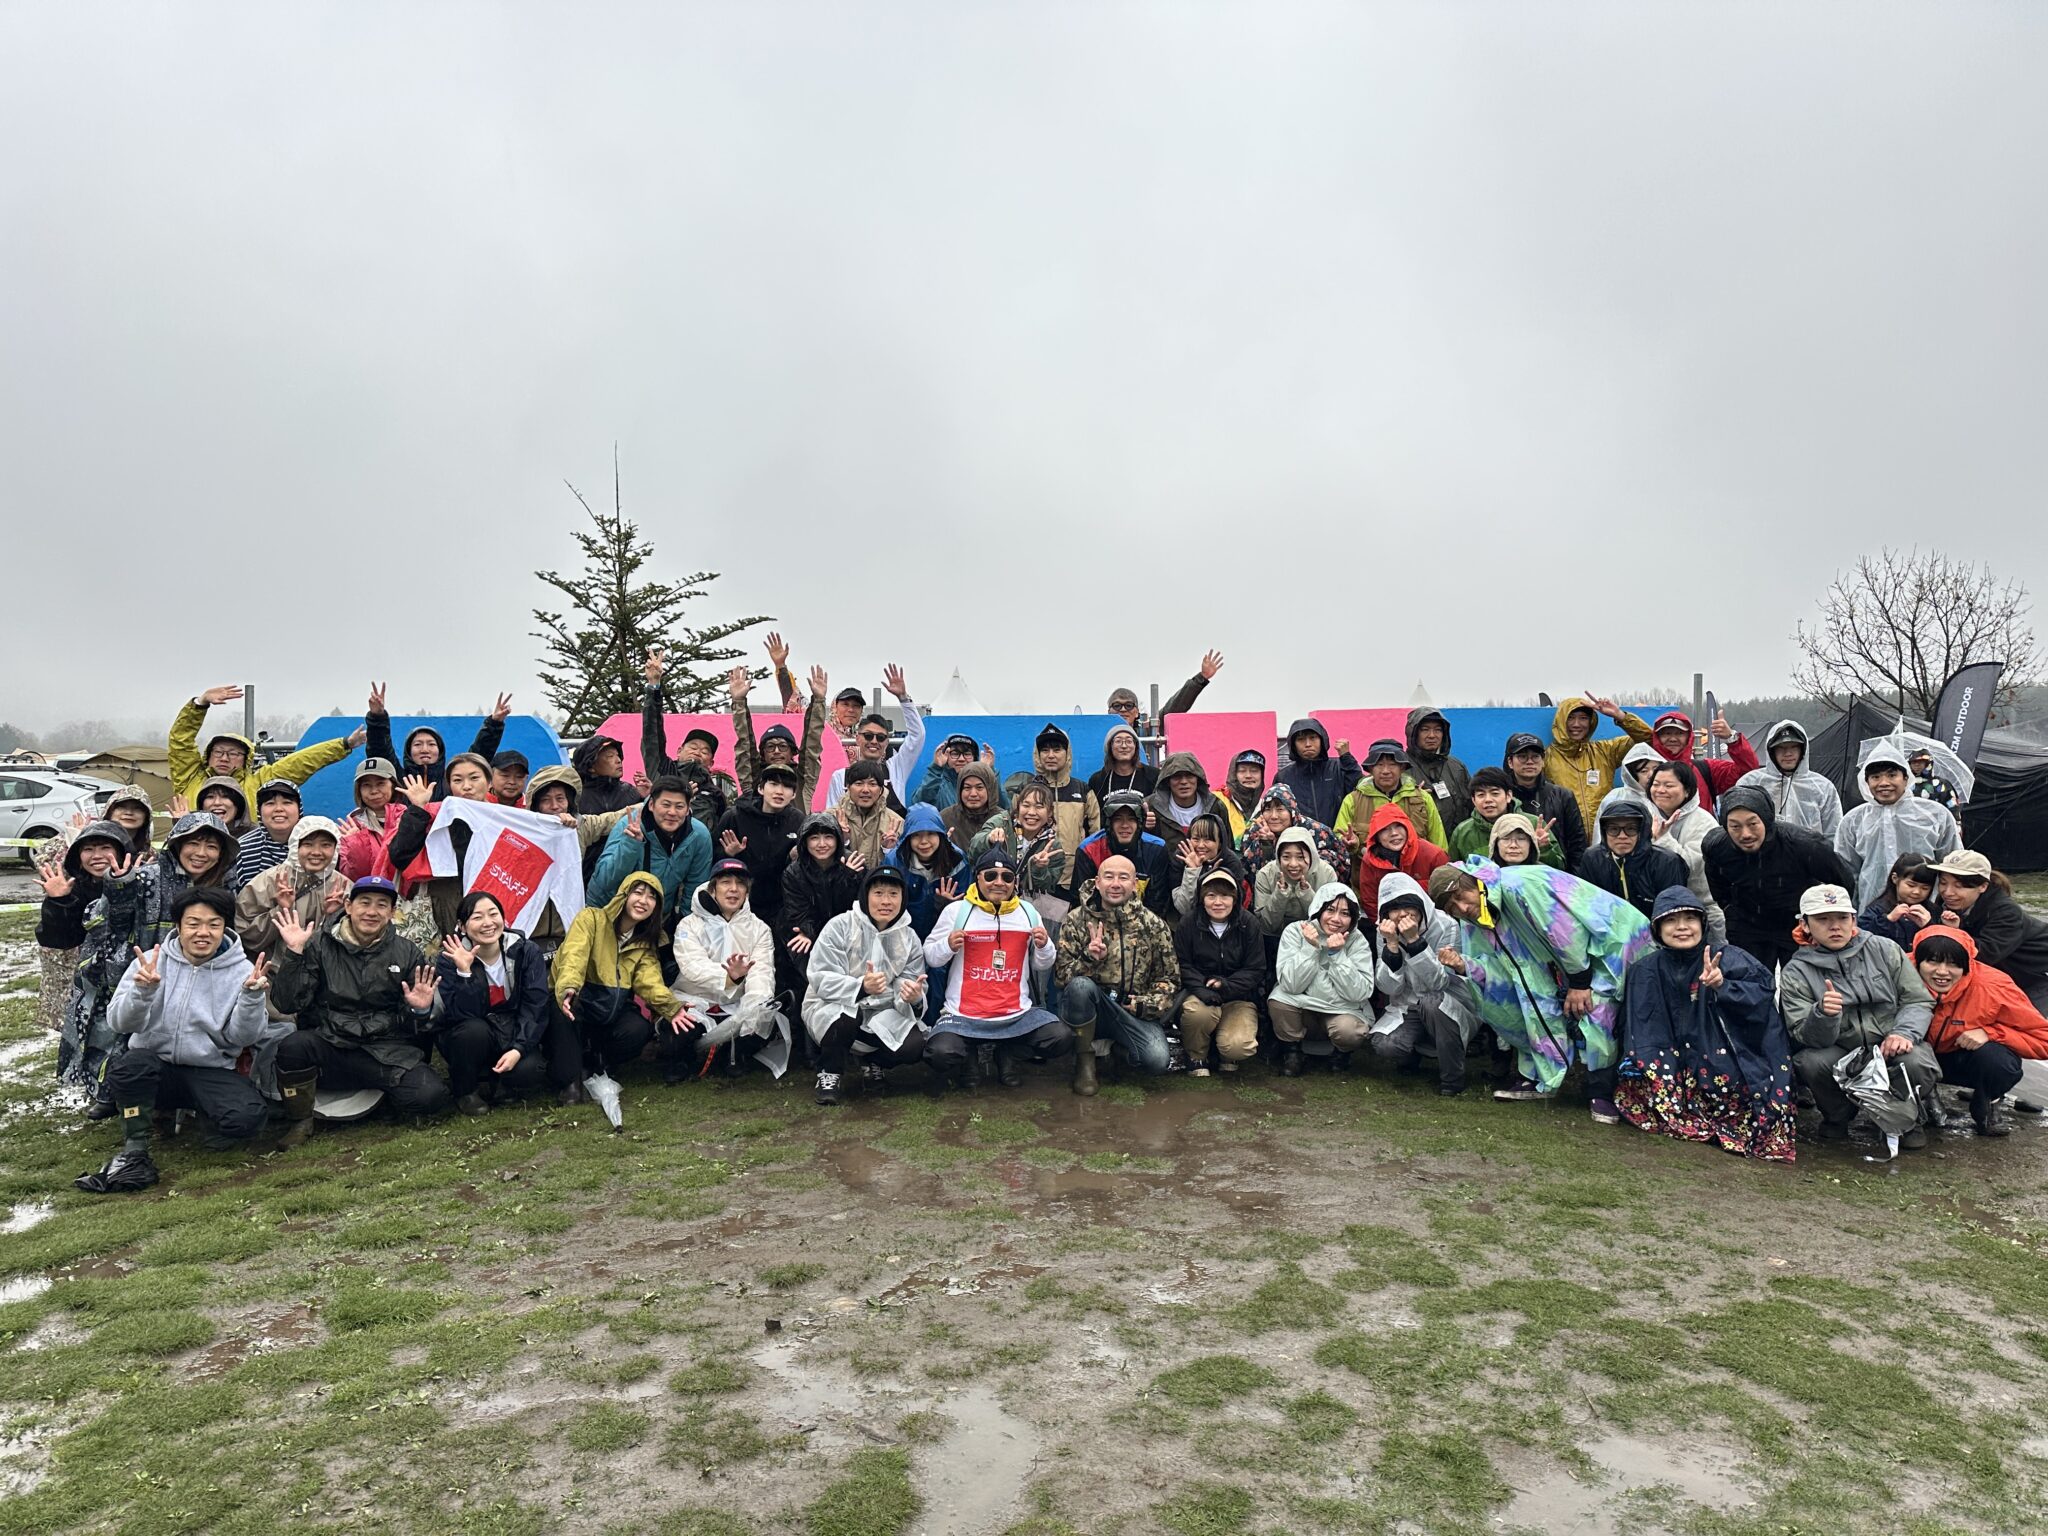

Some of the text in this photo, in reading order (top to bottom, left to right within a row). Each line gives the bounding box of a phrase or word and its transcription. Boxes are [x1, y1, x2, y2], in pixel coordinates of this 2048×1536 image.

[1955, 686, 1974, 735] OUTDOOR
[489, 862, 529, 897] STAFF
[970, 966, 1018, 982] STAFF
